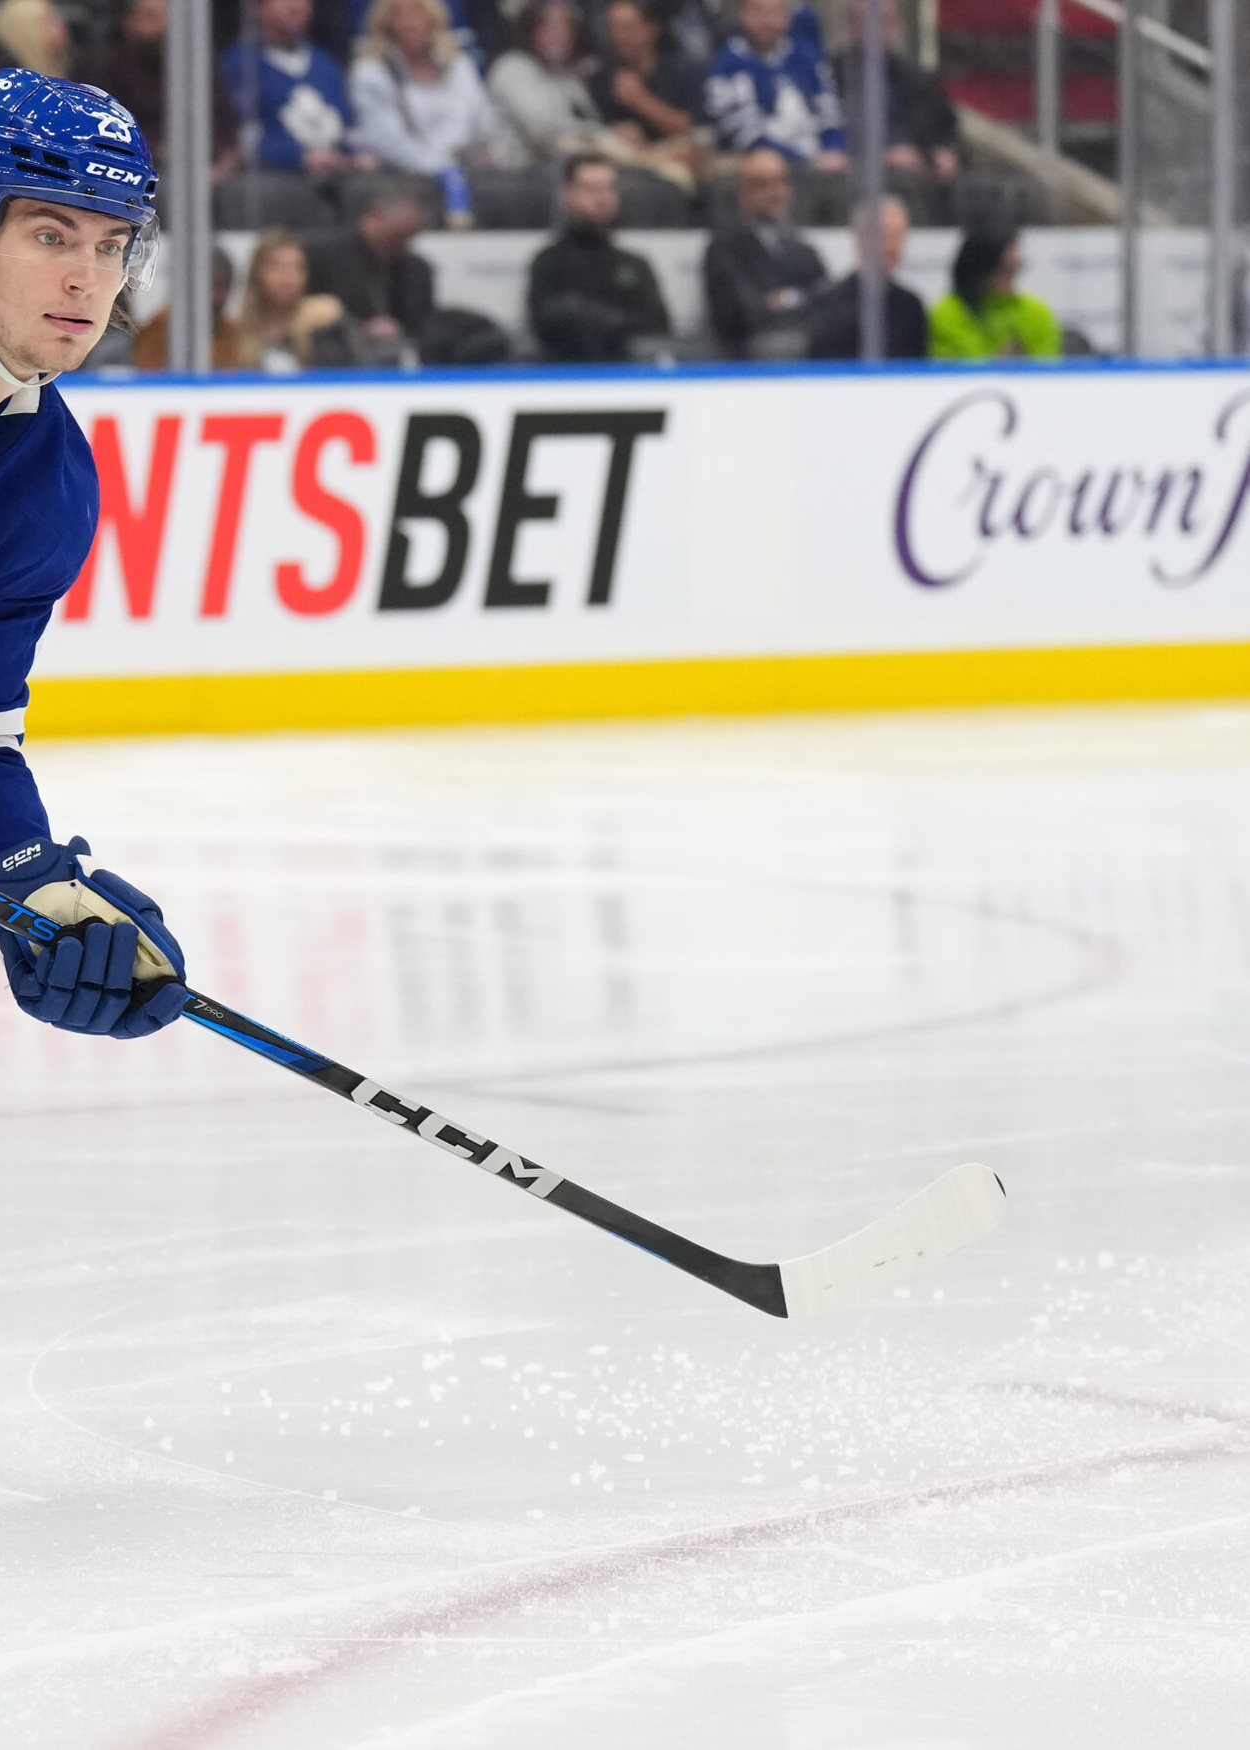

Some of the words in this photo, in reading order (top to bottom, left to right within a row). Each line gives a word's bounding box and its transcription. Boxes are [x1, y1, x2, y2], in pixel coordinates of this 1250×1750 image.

[85, 162, 143, 186] CCM
[2, 843, 42, 869] CCM
[350, 1078, 565, 1199] CCM
